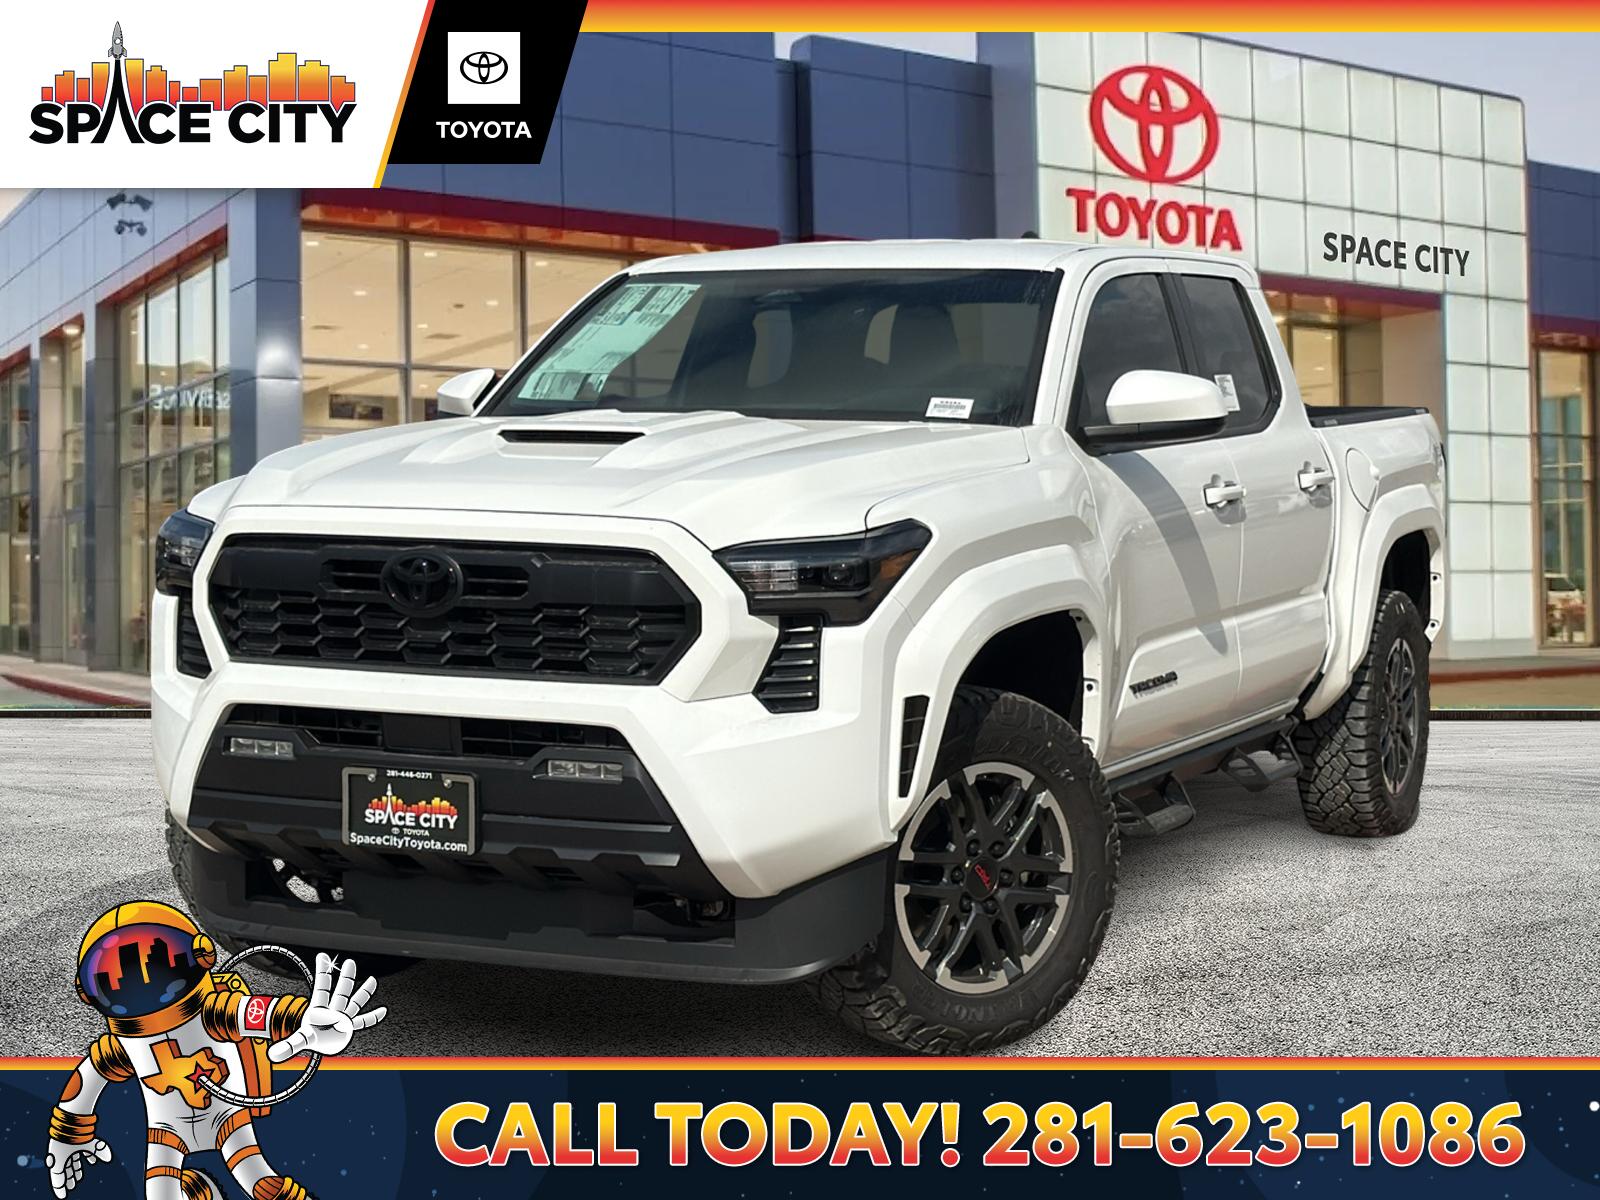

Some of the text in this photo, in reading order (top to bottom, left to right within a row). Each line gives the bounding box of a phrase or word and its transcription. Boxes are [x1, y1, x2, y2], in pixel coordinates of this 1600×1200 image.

[1066, 187, 1243, 252] TOYOTA
[1323, 231, 1471, 277] SPACE CITY
[419, 813, 458, 829] CITY
[350, 832, 468, 852] SpaceCityToyota.com
[403, 828, 430, 837] TOYOTA
